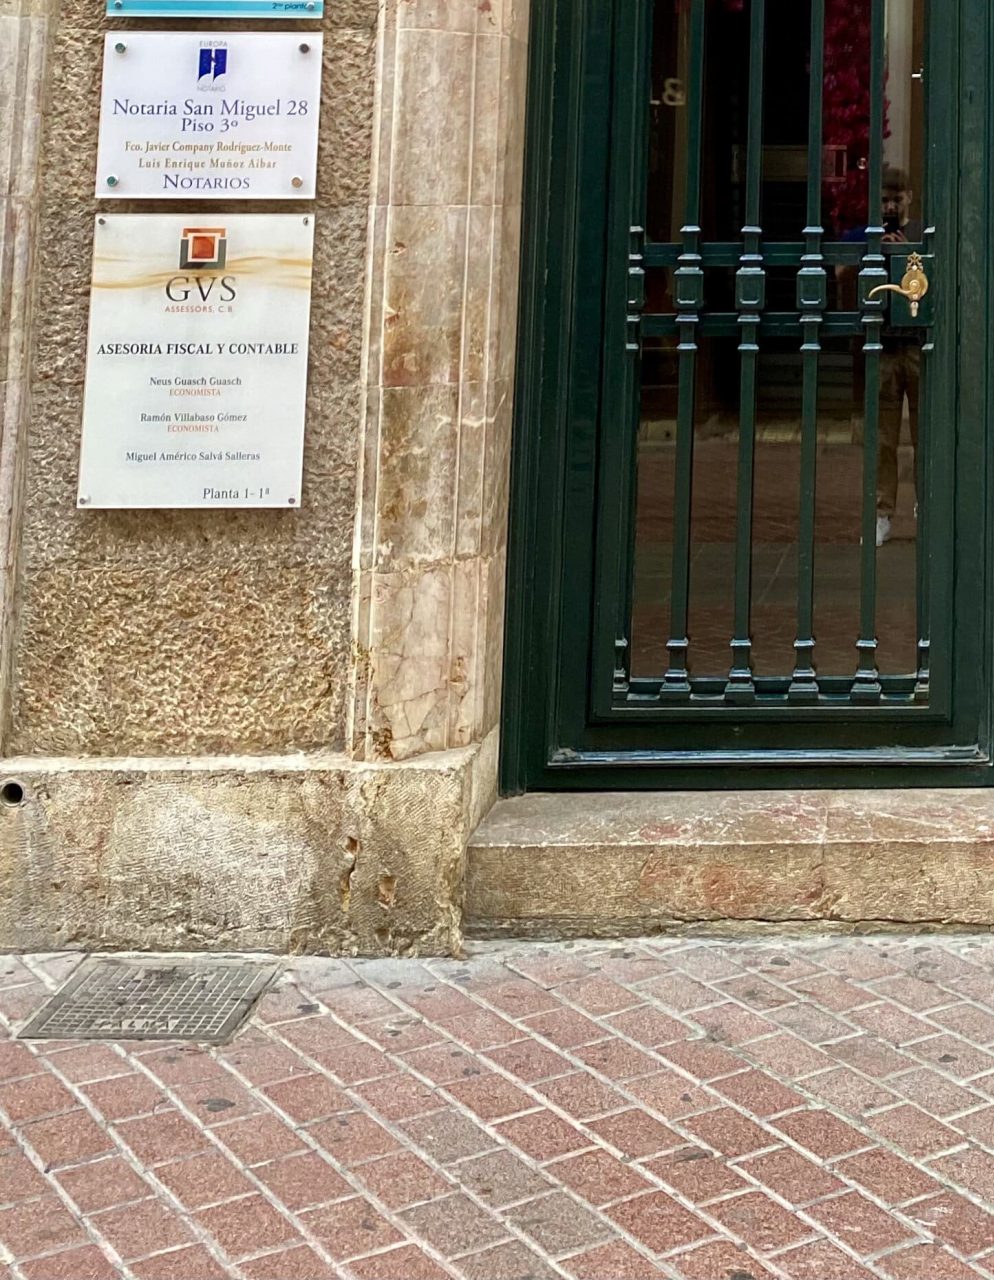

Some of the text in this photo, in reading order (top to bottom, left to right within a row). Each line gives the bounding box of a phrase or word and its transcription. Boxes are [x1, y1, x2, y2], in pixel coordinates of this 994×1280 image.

[112, 99, 309, 121] Notaria San Miguel 28
[181, 117, 214, 133] Piso
[125, 141, 143, 152] Fco.
[145, 141, 170, 153] Javier
[172, 141, 214, 155] Company
[138, 158, 161, 168] Luis
[164, 158, 205, 171] Enrique
[209, 157, 245, 169] Muñoz
[163, 174, 250, 190] NOTARIOS
[165, 276, 236, 302] GVS
[97, 343, 299, 355] ASESORIA FISCAL Y CONTABLE
[150, 376, 242, 386] Neus Guasch Guasch
[169, 388, 221, 397] ECONOMISTA
[140, 412, 247, 423] Ramón Villabaso Gómez
[167, 424, 219, 433] ECONOMISTA
[125, 451, 260, 463] Miguel Américo Salvá Salleras
[203, 487, 239, 499] Planta
